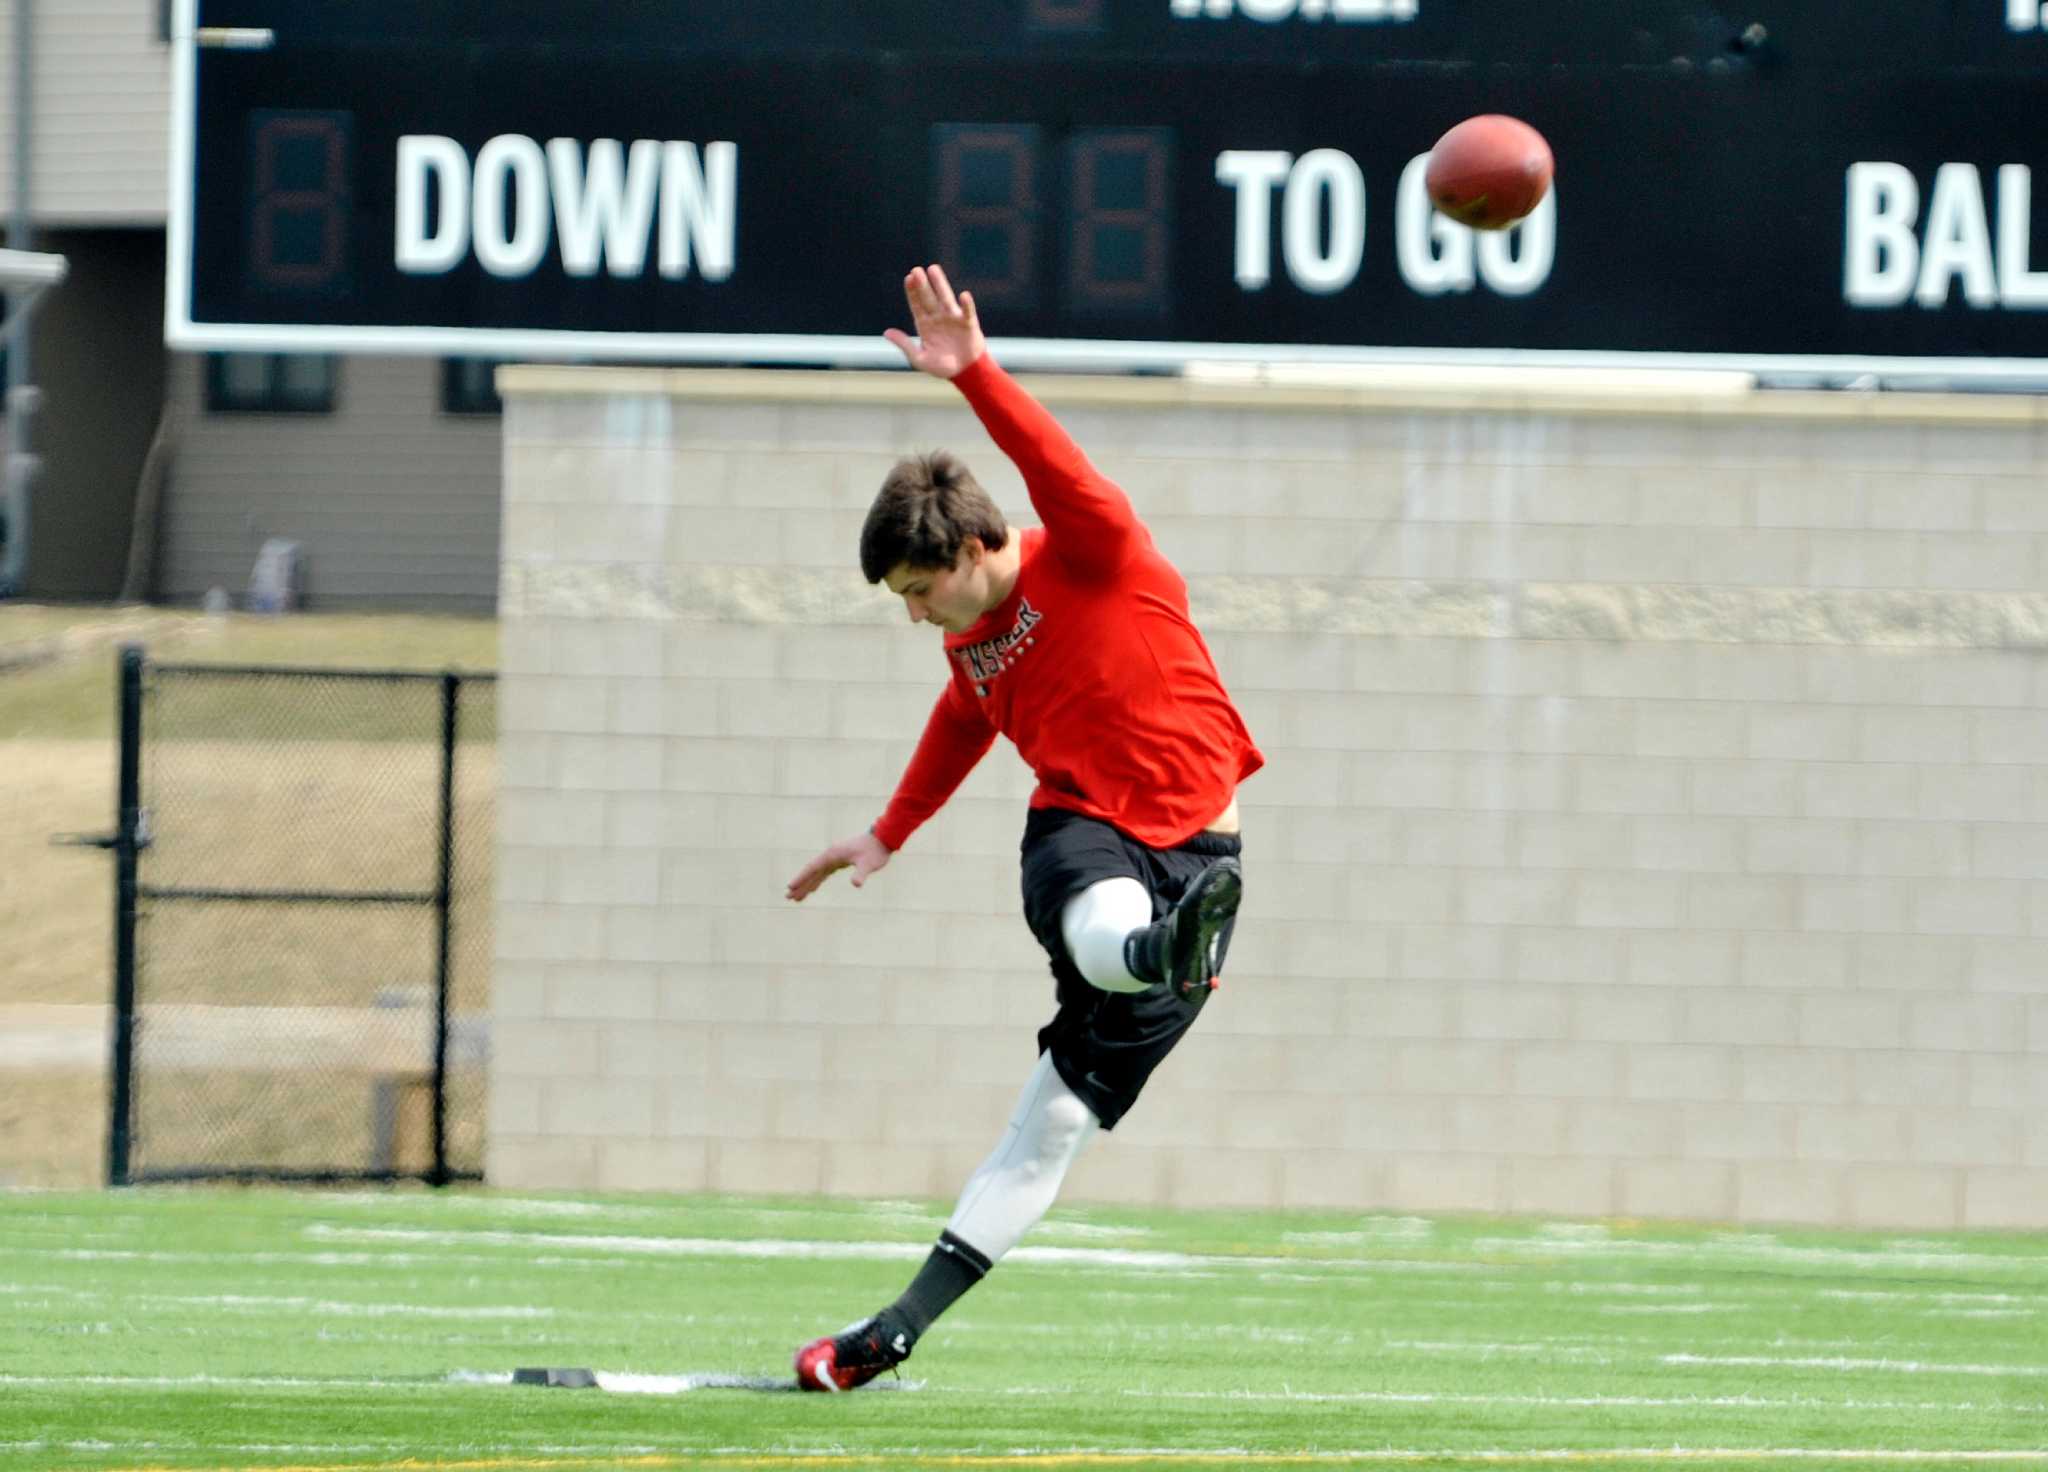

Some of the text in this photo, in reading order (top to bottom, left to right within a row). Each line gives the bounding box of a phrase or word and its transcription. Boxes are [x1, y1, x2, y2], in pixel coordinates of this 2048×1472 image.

[395, 133, 738, 282] DOWN
[1215, 148, 1366, 294] TO
[1843, 161, 2048, 309] BAL
